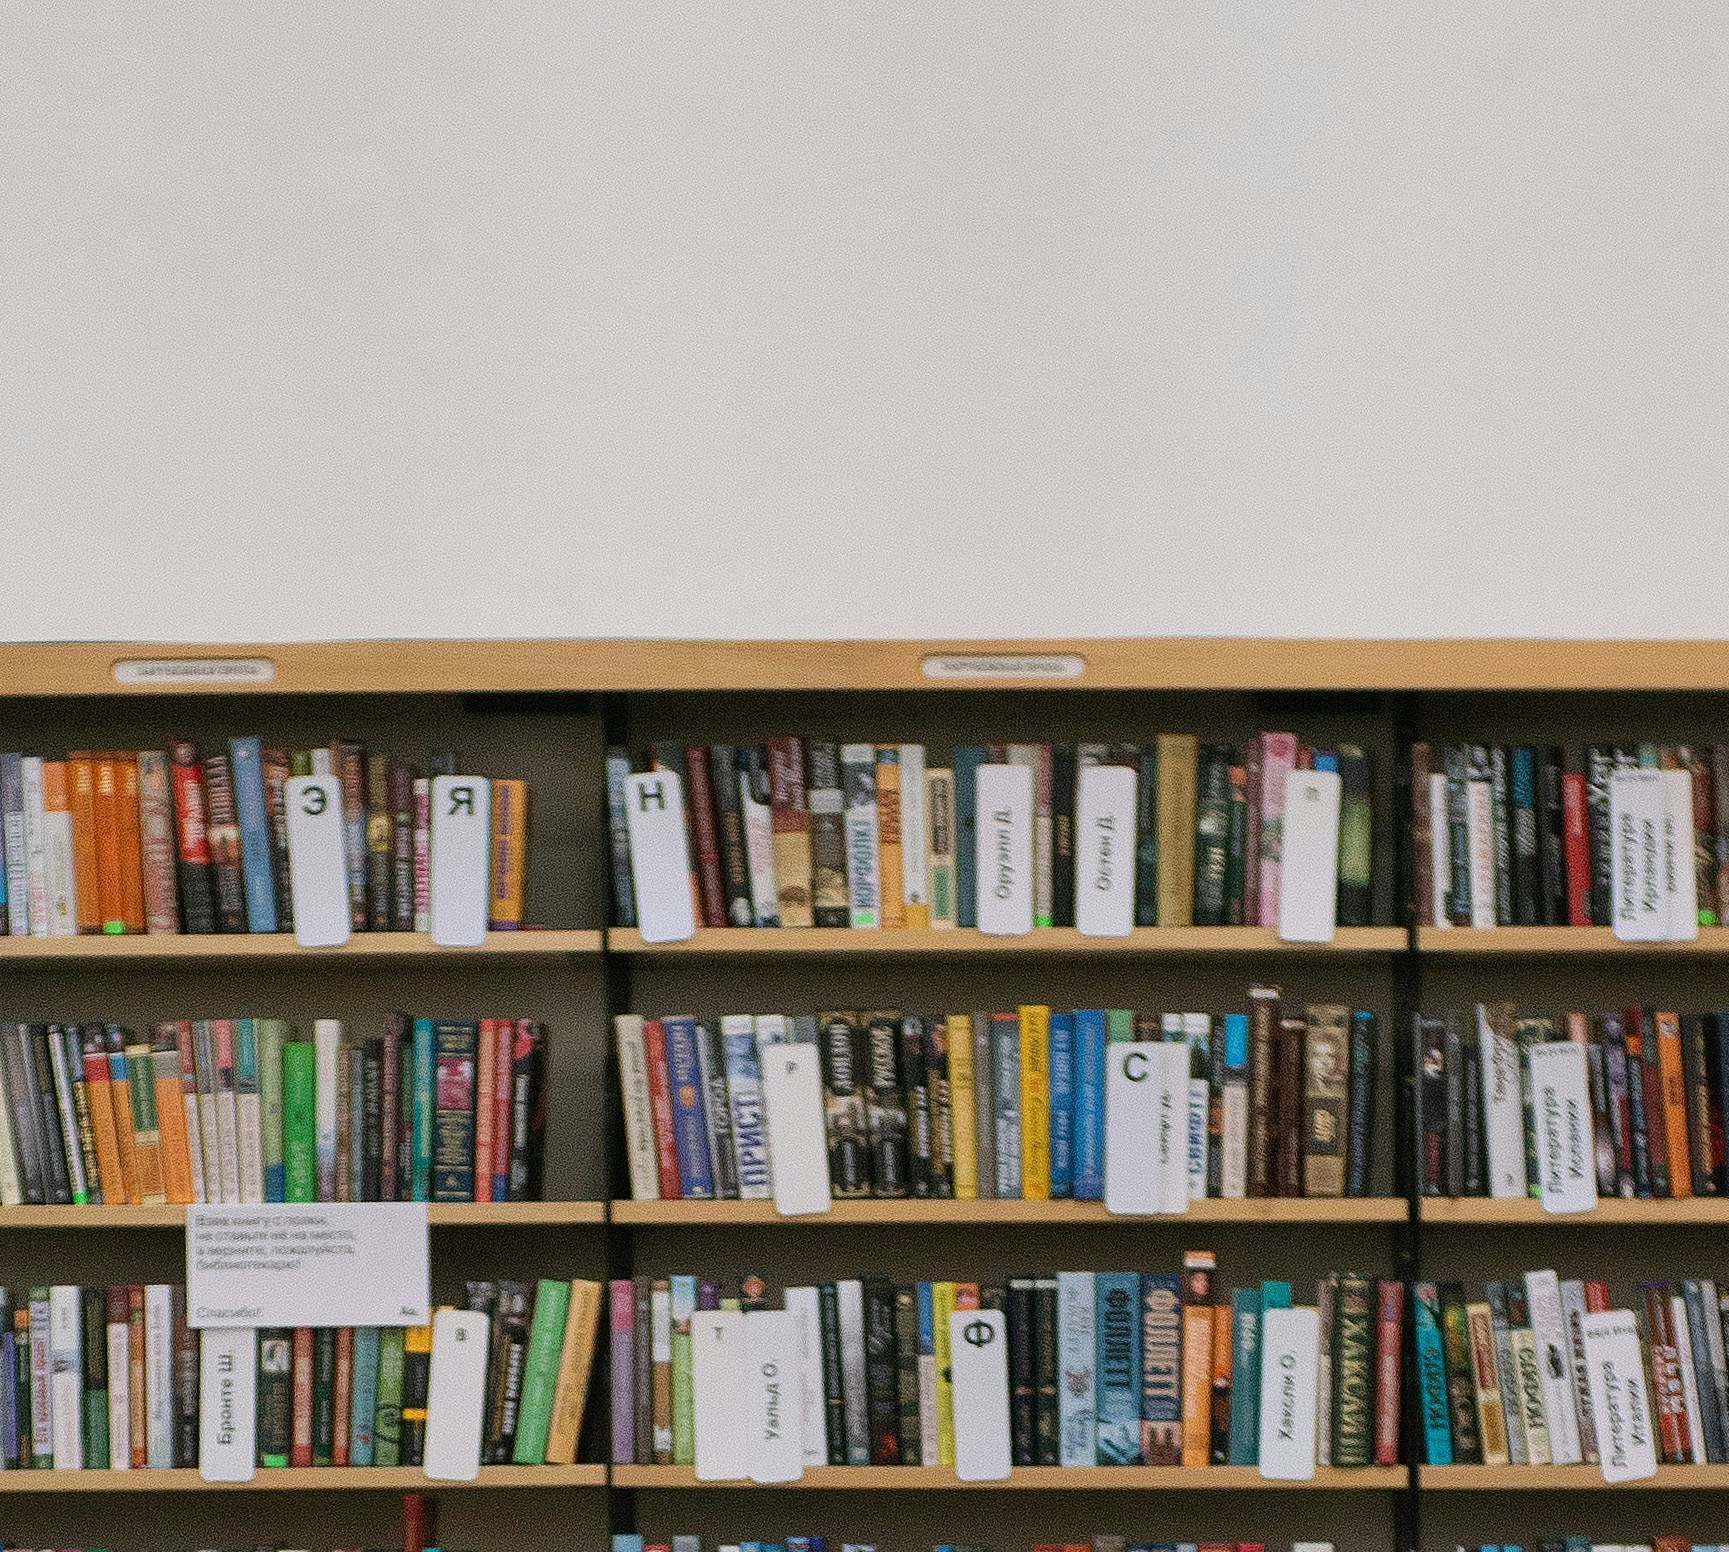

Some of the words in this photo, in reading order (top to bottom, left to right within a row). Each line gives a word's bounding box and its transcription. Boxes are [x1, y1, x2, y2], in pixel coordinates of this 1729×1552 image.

[302, 785, 329, 817] Э
[448, 786, 475, 816] Я
[638, 782, 665, 812] Н
[852, 827, 875, 909] НОРФОЛК
[994, 829, 1015, 900] Оруэлл
[1095, 835, 1113, 892] Остен
[1619, 812, 1637, 920] Литература
[1642, 819, 1657, 912] Ирландии
[1122, 1051, 1148, 1083] С
[736, 1097, 766, 1186] ПРИСТ
[1542, 1086, 1562, 1194] Литература
[1566, 1099, 1583, 1179] Испании
[713, 1325, 724, 1341] Т
[963, 1320, 995, 1349] Ф
[1102, 1288, 1132, 1392] ФОЛЛЕТТ
[1143, 1294, 1178, 1400] ФОЛЛЕТТ
[217, 1378, 236, 1446] Бронте
[765, 1382, 781, 1441] Уальд
[1278, 1374, 1295, 1441] Хаксли
[1594, 1357, 1625, 1472] Литература
[1627, 1375, 1648, 1445] Италии
